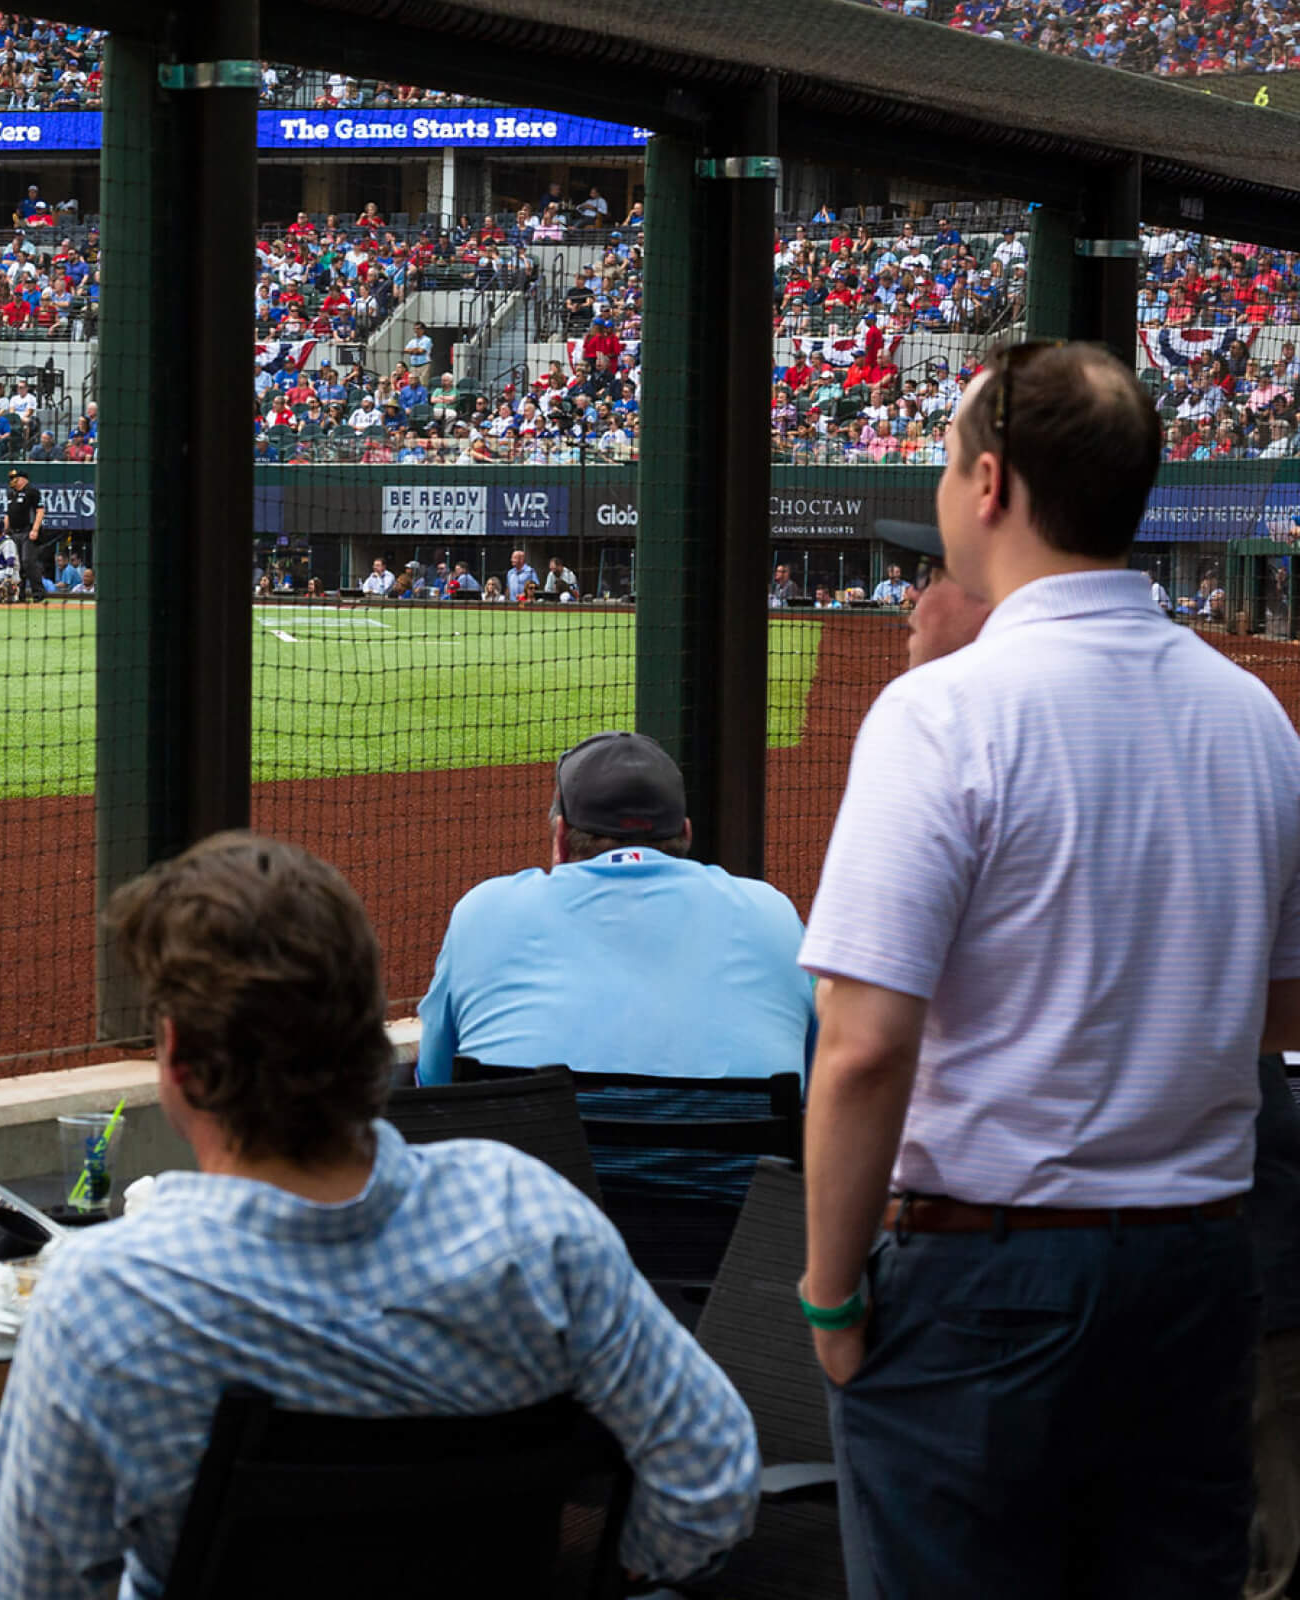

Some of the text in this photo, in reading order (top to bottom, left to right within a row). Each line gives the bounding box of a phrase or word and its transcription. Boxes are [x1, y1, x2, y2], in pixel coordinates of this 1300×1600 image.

[281, 117, 557, 140] The Game Starts Here
[390, 491, 478, 506] BE READY
[393, 511, 474, 529] for Real
[1144, 506, 1189, 522] PARTNER
[1192, 506, 1205, 522] OF
[1208, 506, 1227, 522] THE
